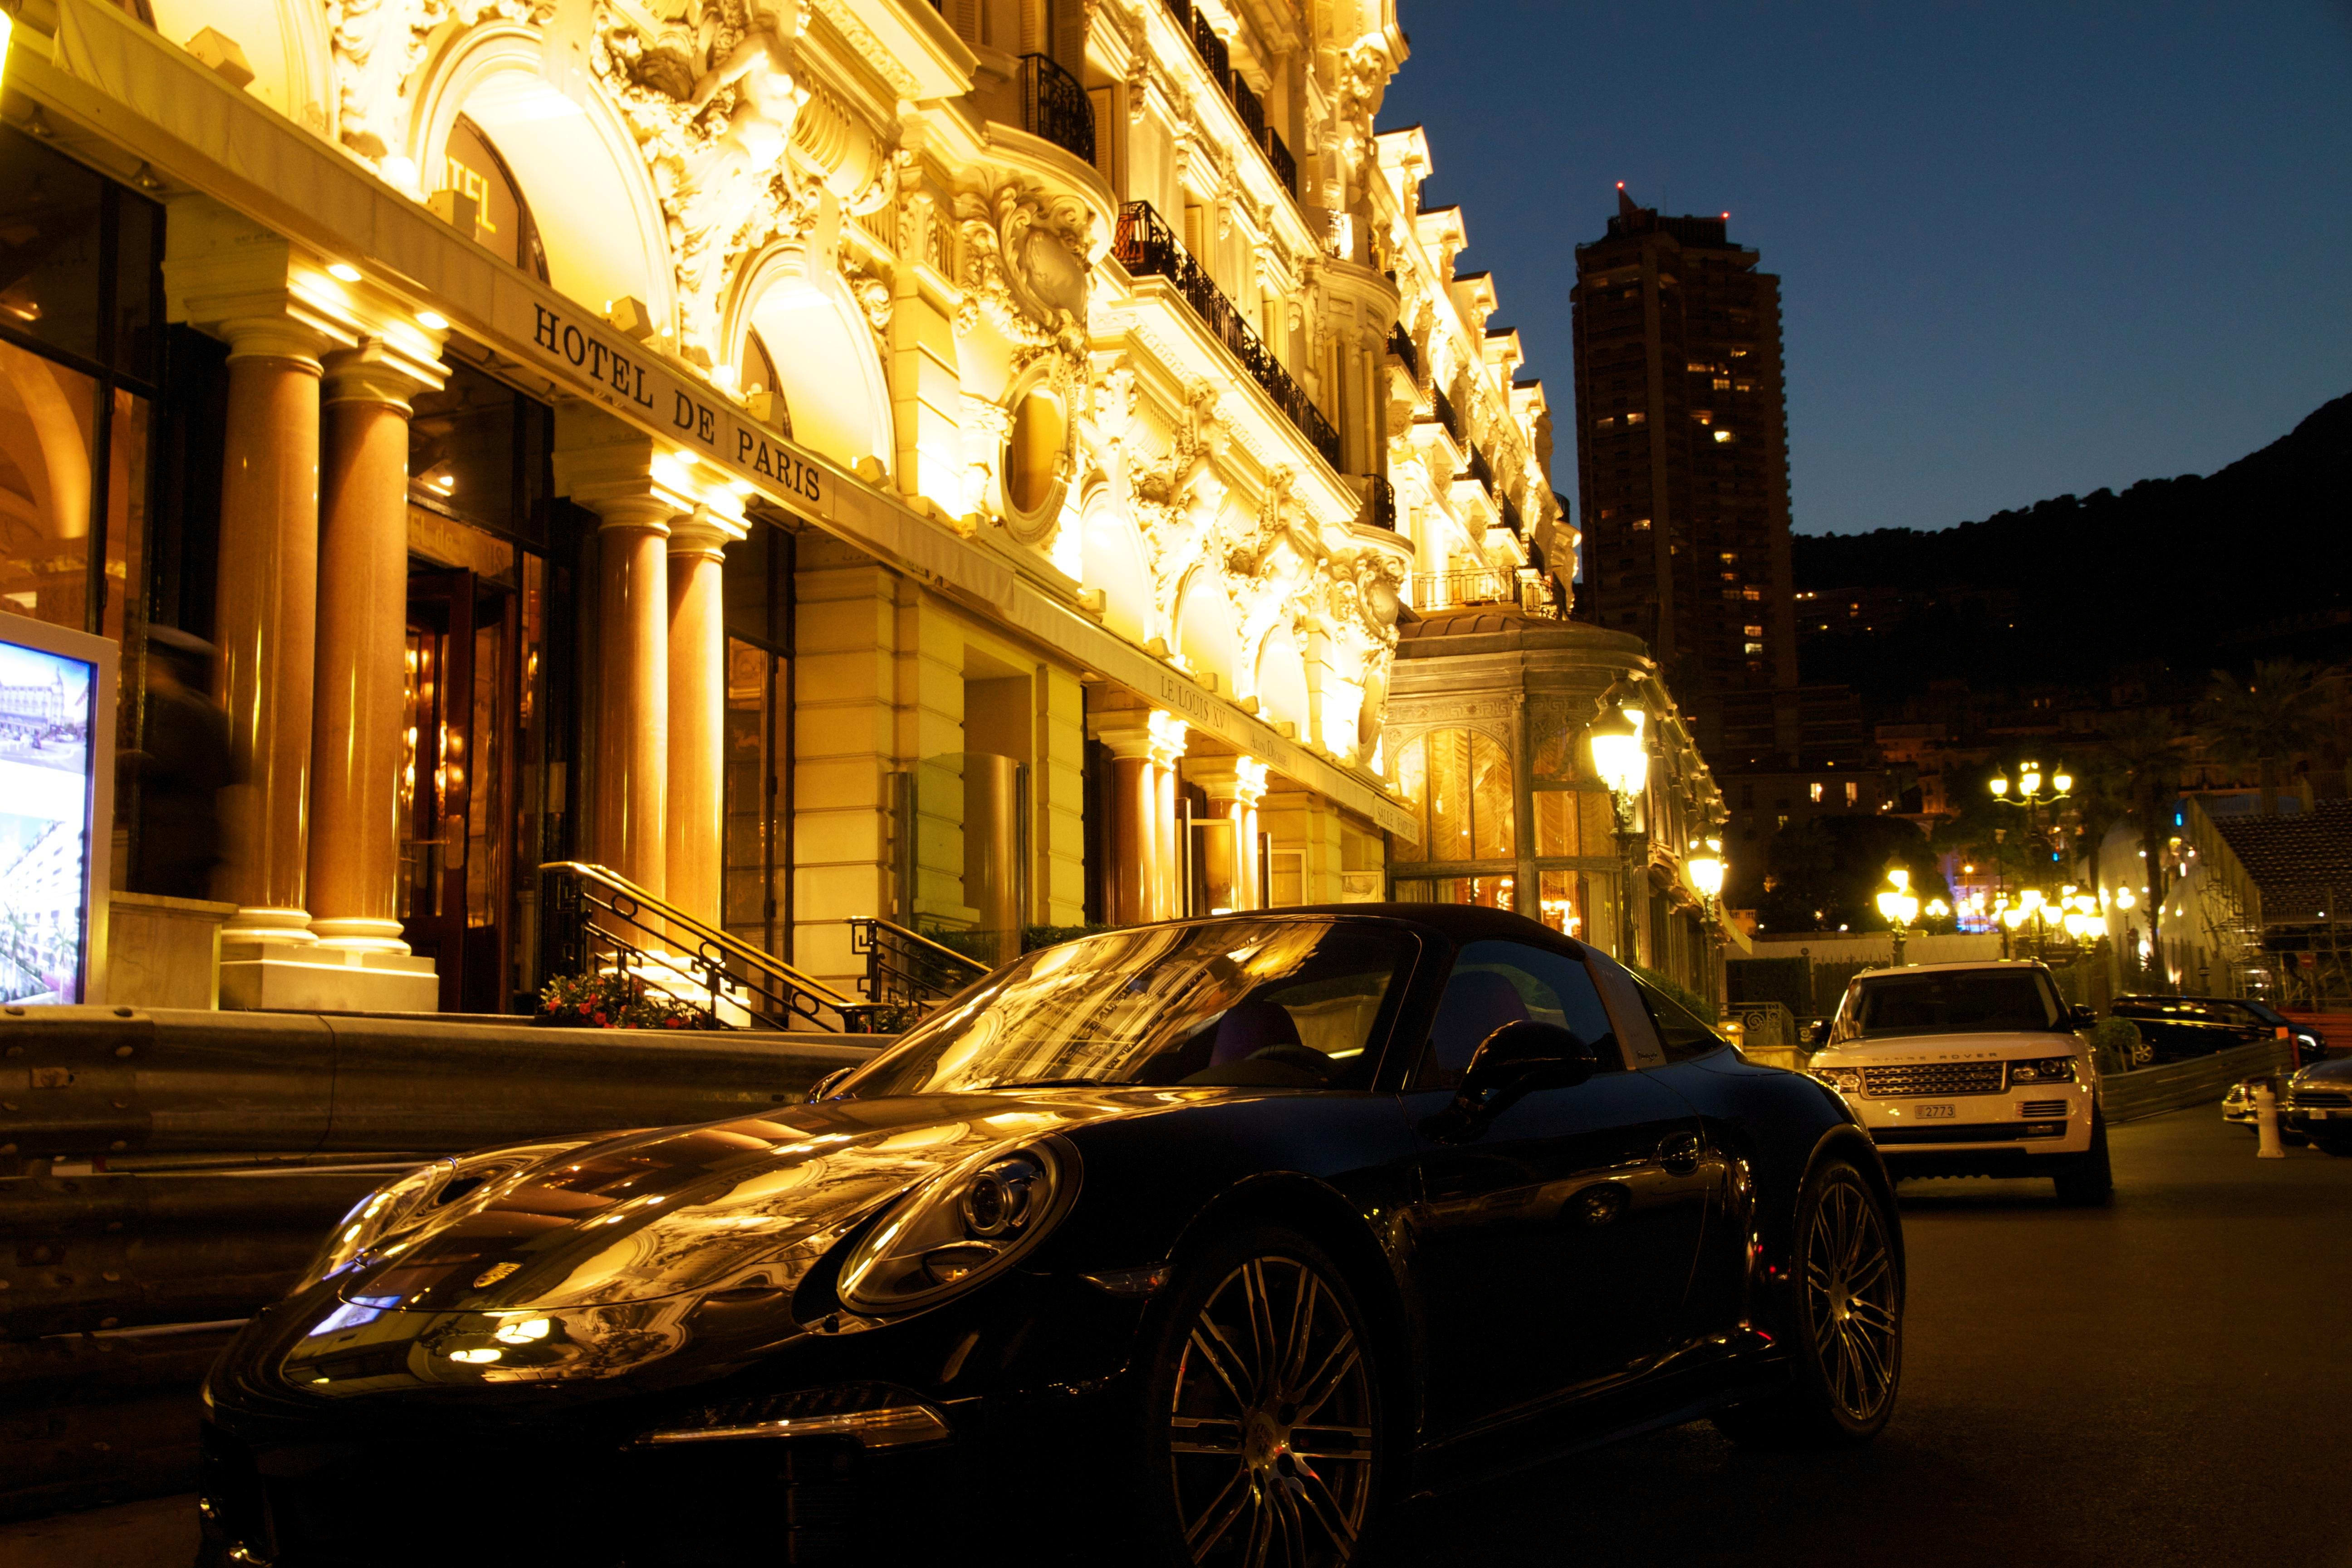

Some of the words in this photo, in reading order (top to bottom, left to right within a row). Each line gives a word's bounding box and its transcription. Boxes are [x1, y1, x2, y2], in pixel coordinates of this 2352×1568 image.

[534, 302, 653, 409] HOTEL
[673, 389, 715, 446] DE
[737, 426, 820, 502] PARIS
[1161, 676, 1174, 702] LE
[1179, 686, 1209, 721] LOUIS
[1213, 706, 1225, 729] XV
[1377, 805, 1394, 828] SALLE
[1926, 1107, 1954, 1117] 2773
